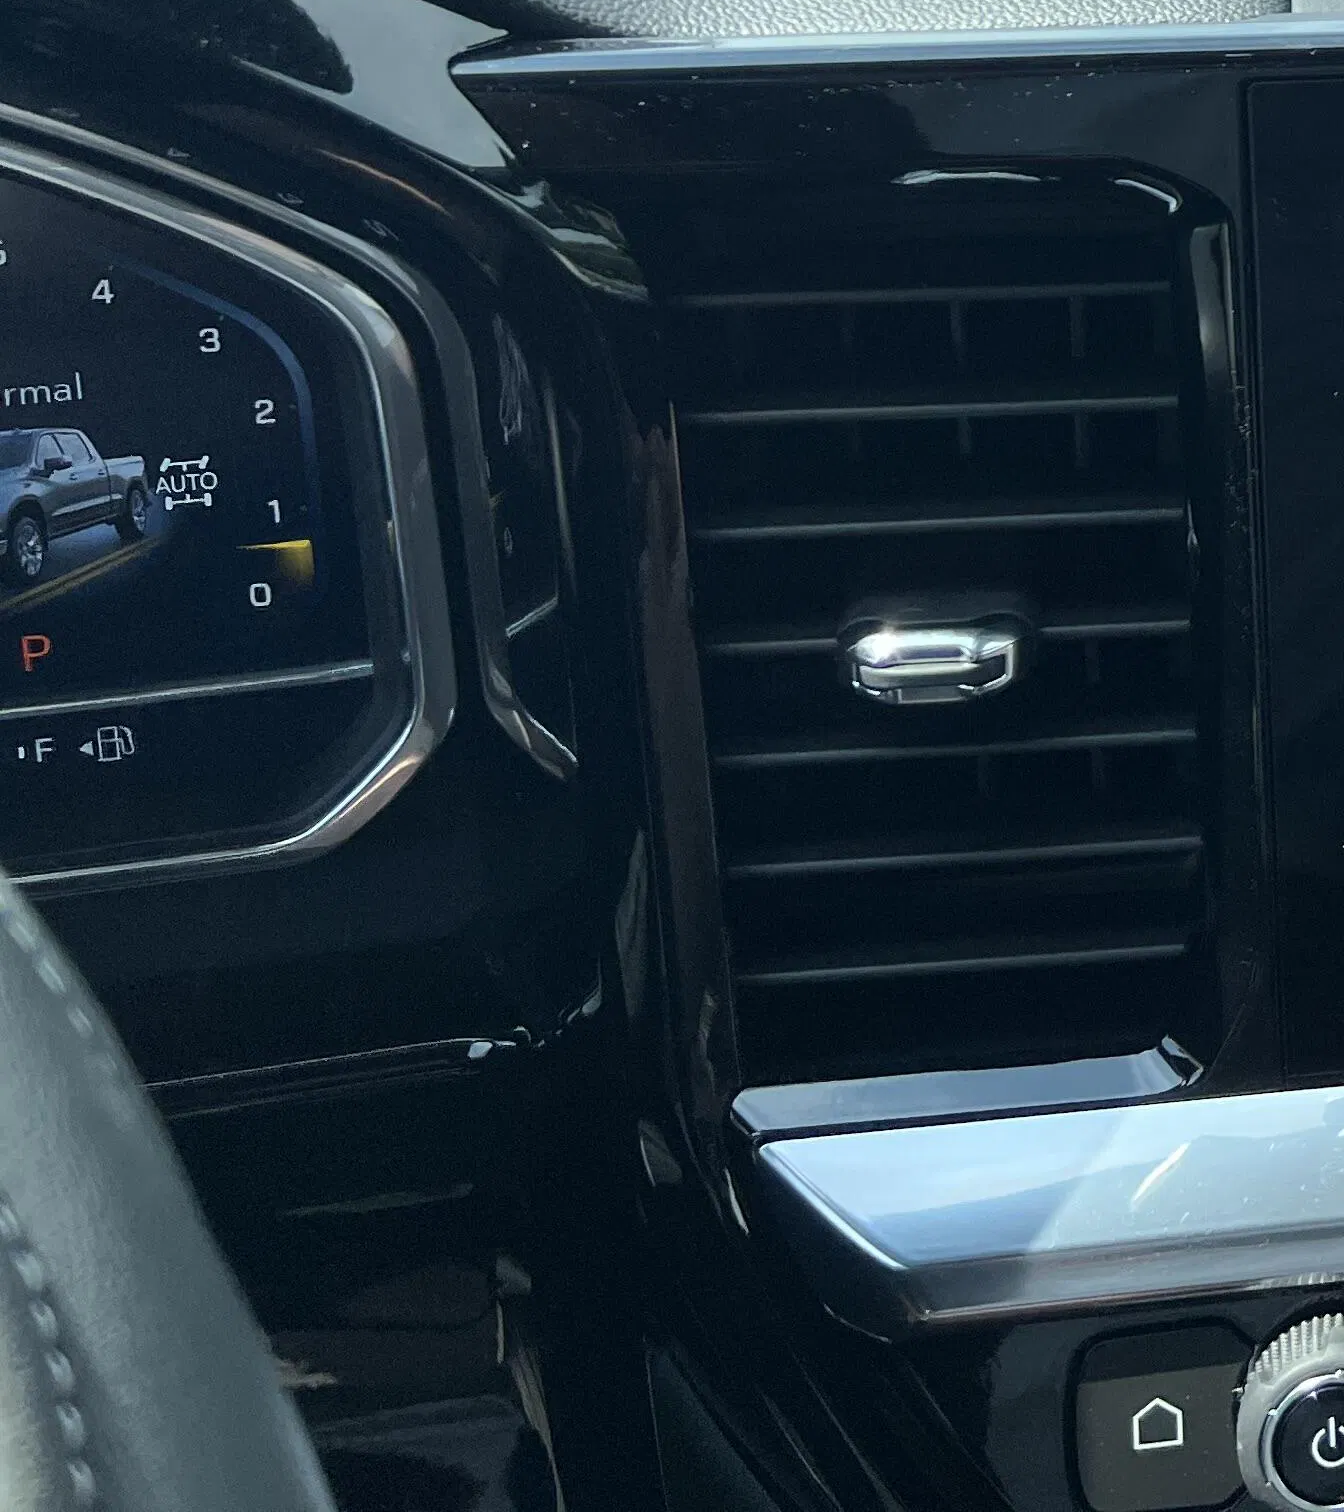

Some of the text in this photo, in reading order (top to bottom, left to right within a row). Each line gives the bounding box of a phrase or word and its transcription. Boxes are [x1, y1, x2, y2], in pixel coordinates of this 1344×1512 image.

[92, 279, 114, 304] 4
[200, 328, 221, 353] 3
[255, 400, 277, 425] 2
[156, 471, 218, 494] AUTO
[268, 500, 281, 523] 1
[250, 582, 272, 607] 0
[21, 635, 51, 672] P
[36, 738, 54, 763] F
